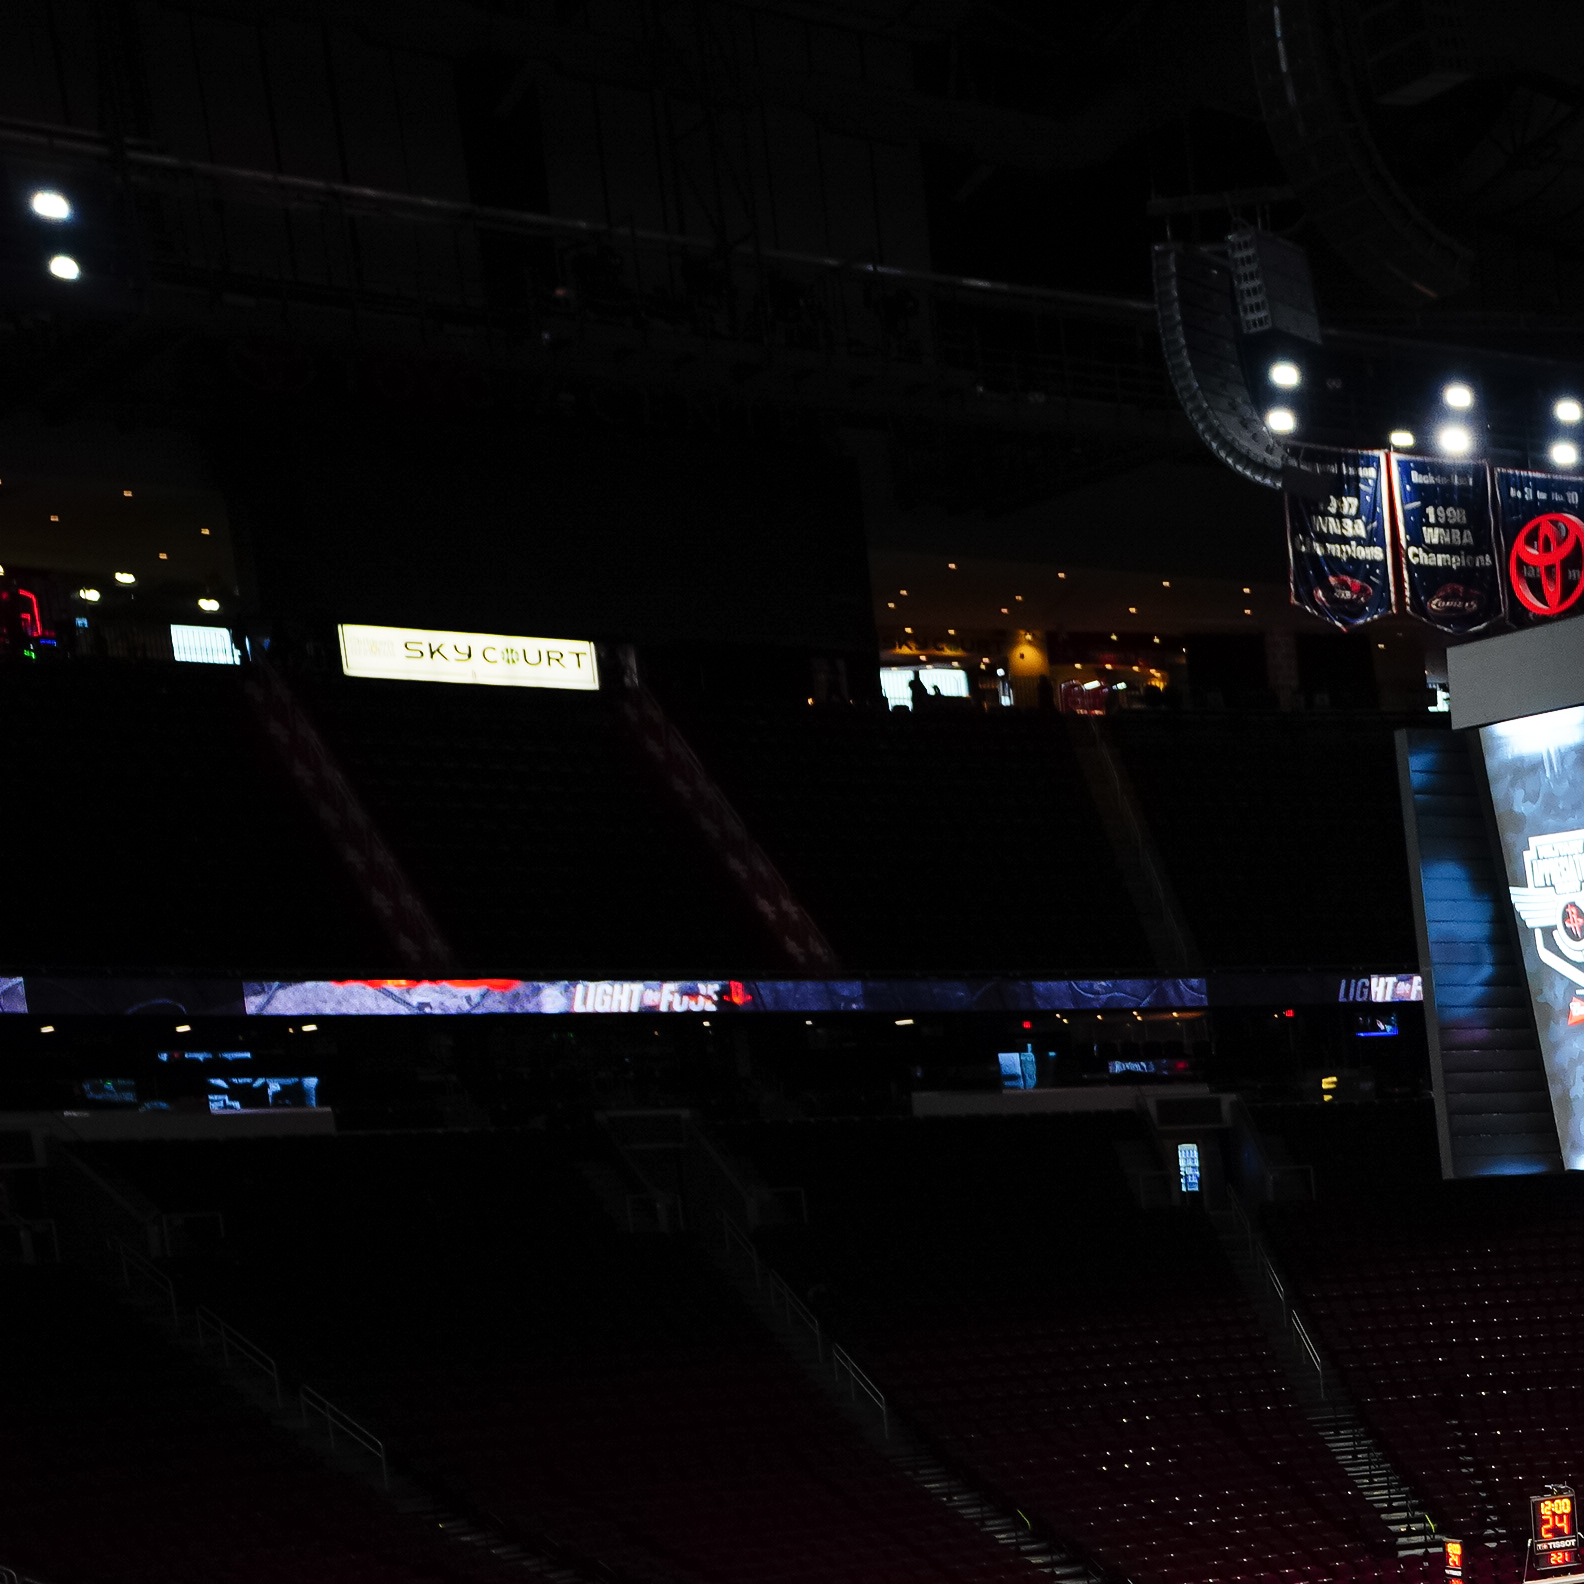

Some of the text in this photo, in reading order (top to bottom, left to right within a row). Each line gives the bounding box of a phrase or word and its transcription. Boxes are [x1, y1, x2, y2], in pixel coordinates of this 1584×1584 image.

[1425, 505, 1466, 524] 1998
[1422, 527, 1474, 547] WNBA
[1408, 546, 1492, 568] Champions
[404, 641, 472, 662] SKY
[573, 983, 644, 1013] LIGHT
[1338, 977, 1398, 1002] LIGHT
[1541, 1498, 1571, 1515] 12:00
[1541, 1514, 1569, 1539] 24
[1549, 1539, 1576, 1550] TISSOT
